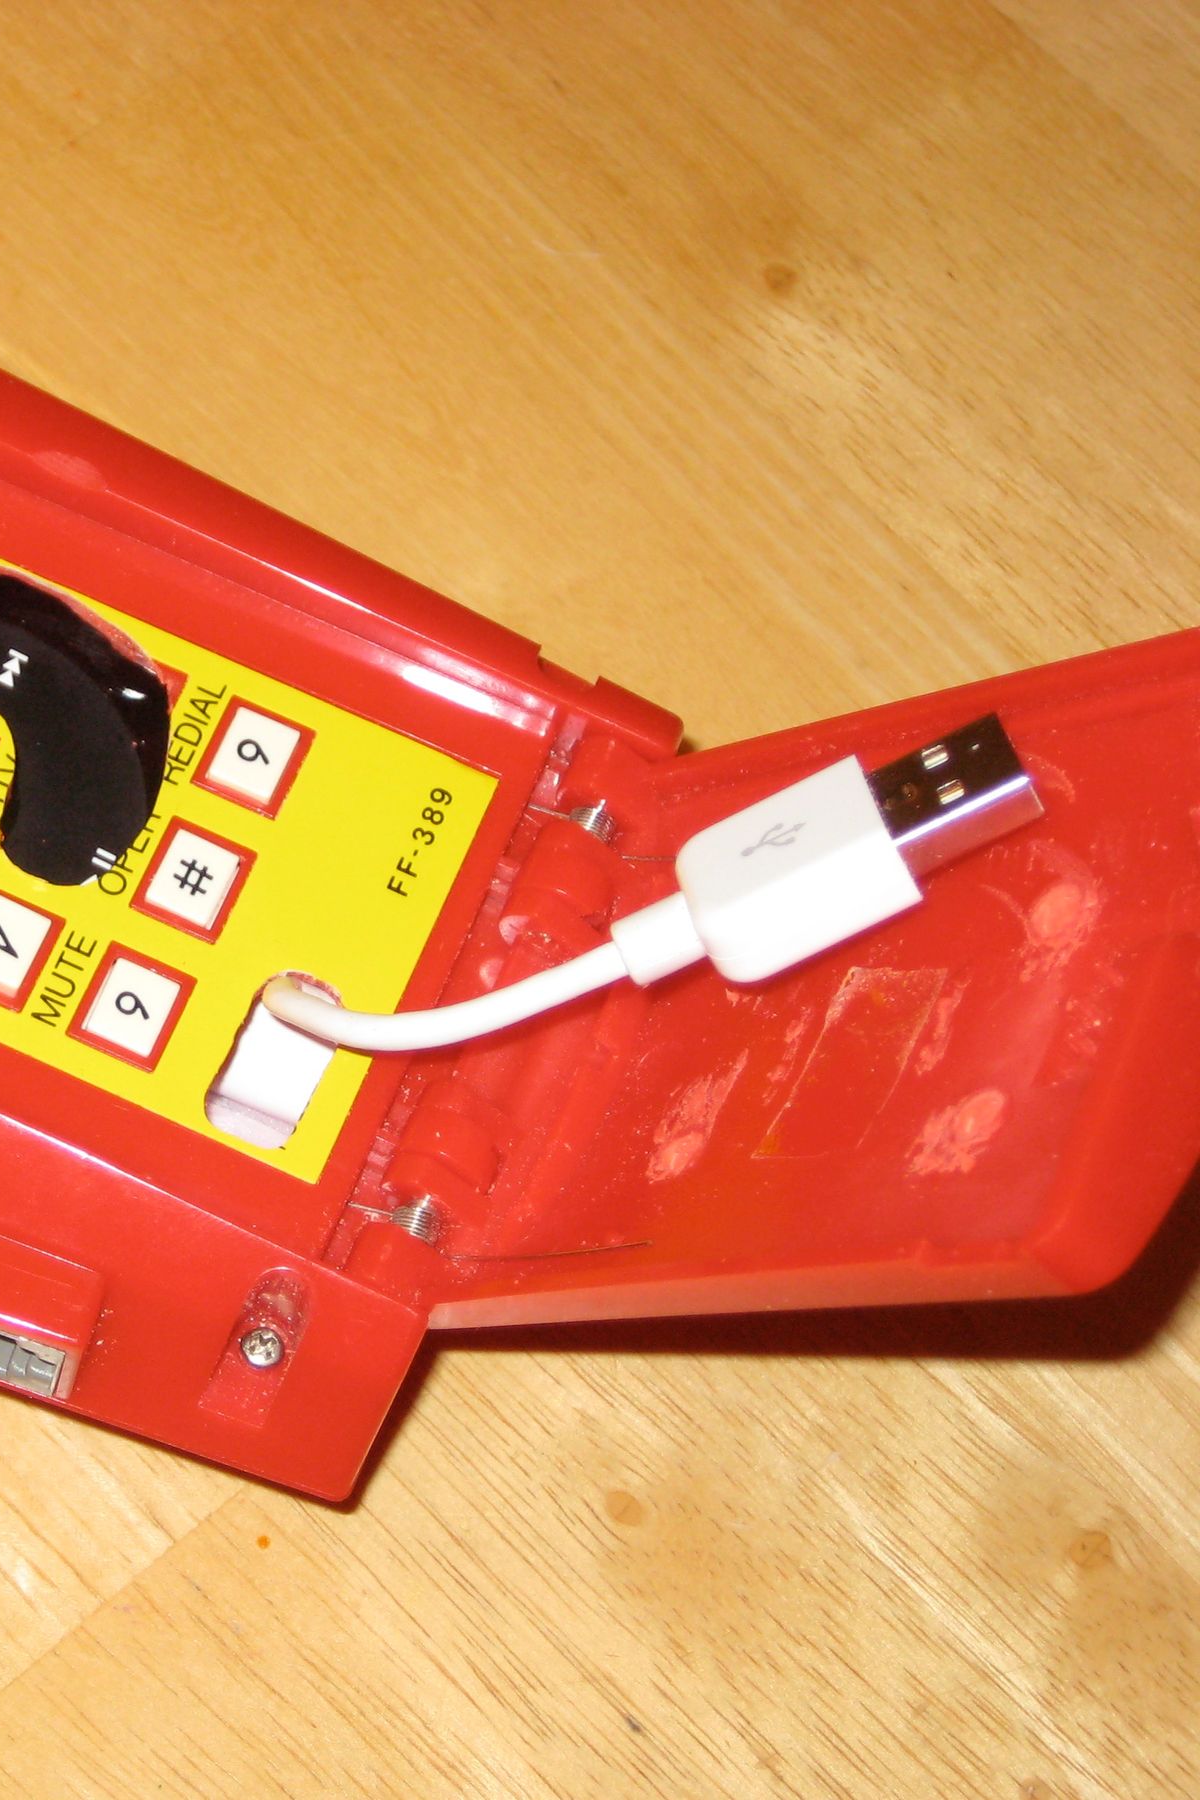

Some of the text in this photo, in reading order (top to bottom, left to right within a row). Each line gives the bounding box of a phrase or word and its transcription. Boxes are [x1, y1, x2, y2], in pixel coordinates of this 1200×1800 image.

[164, 685, 226, 786] REDIAL
[173, 859, 212, 895] #
[387, 786, 454, 898] FF-389
[30, 931, 97, 1026] MUTE
